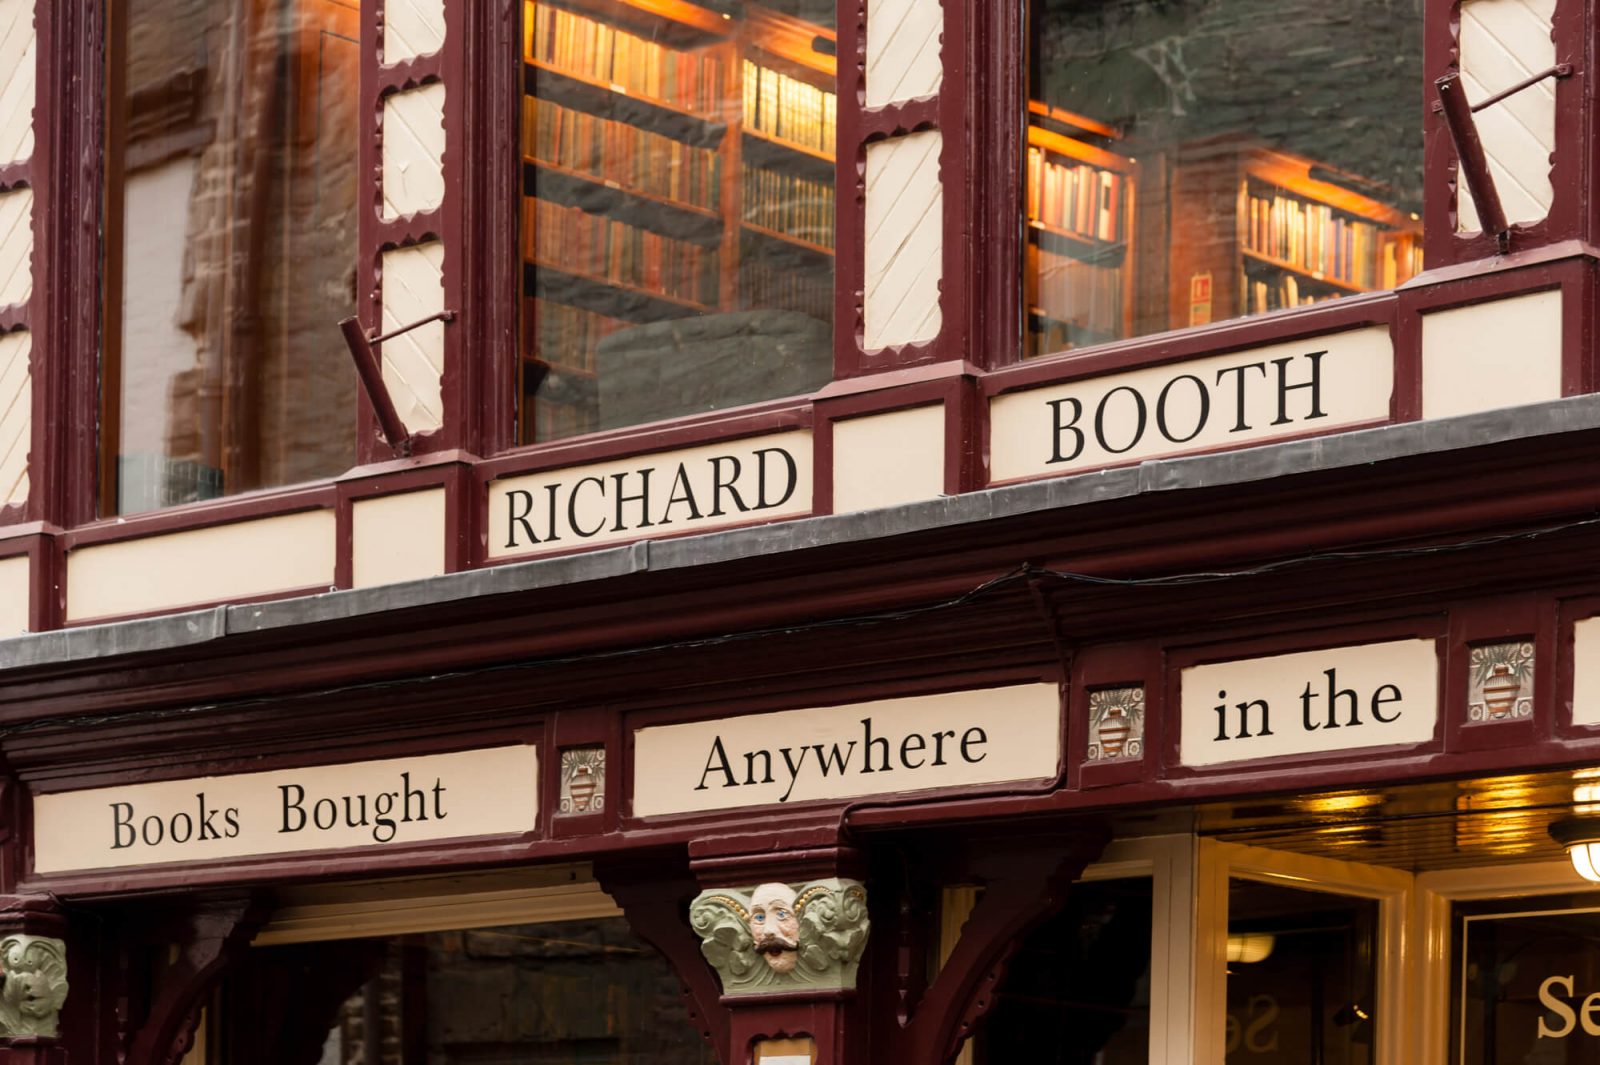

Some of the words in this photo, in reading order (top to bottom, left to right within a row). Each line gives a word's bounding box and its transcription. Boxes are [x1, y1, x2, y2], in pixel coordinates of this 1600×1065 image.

[504, 447, 798, 549] RICHARD
[1045, 350, 1329, 465] BOOTH
[109, 792, 240, 850] Books
[277, 771, 448, 843] Bought
[694, 717, 988, 803] Anywhere
[1213, 689, 1274, 742] in
[1299, 667, 1403, 732] the
